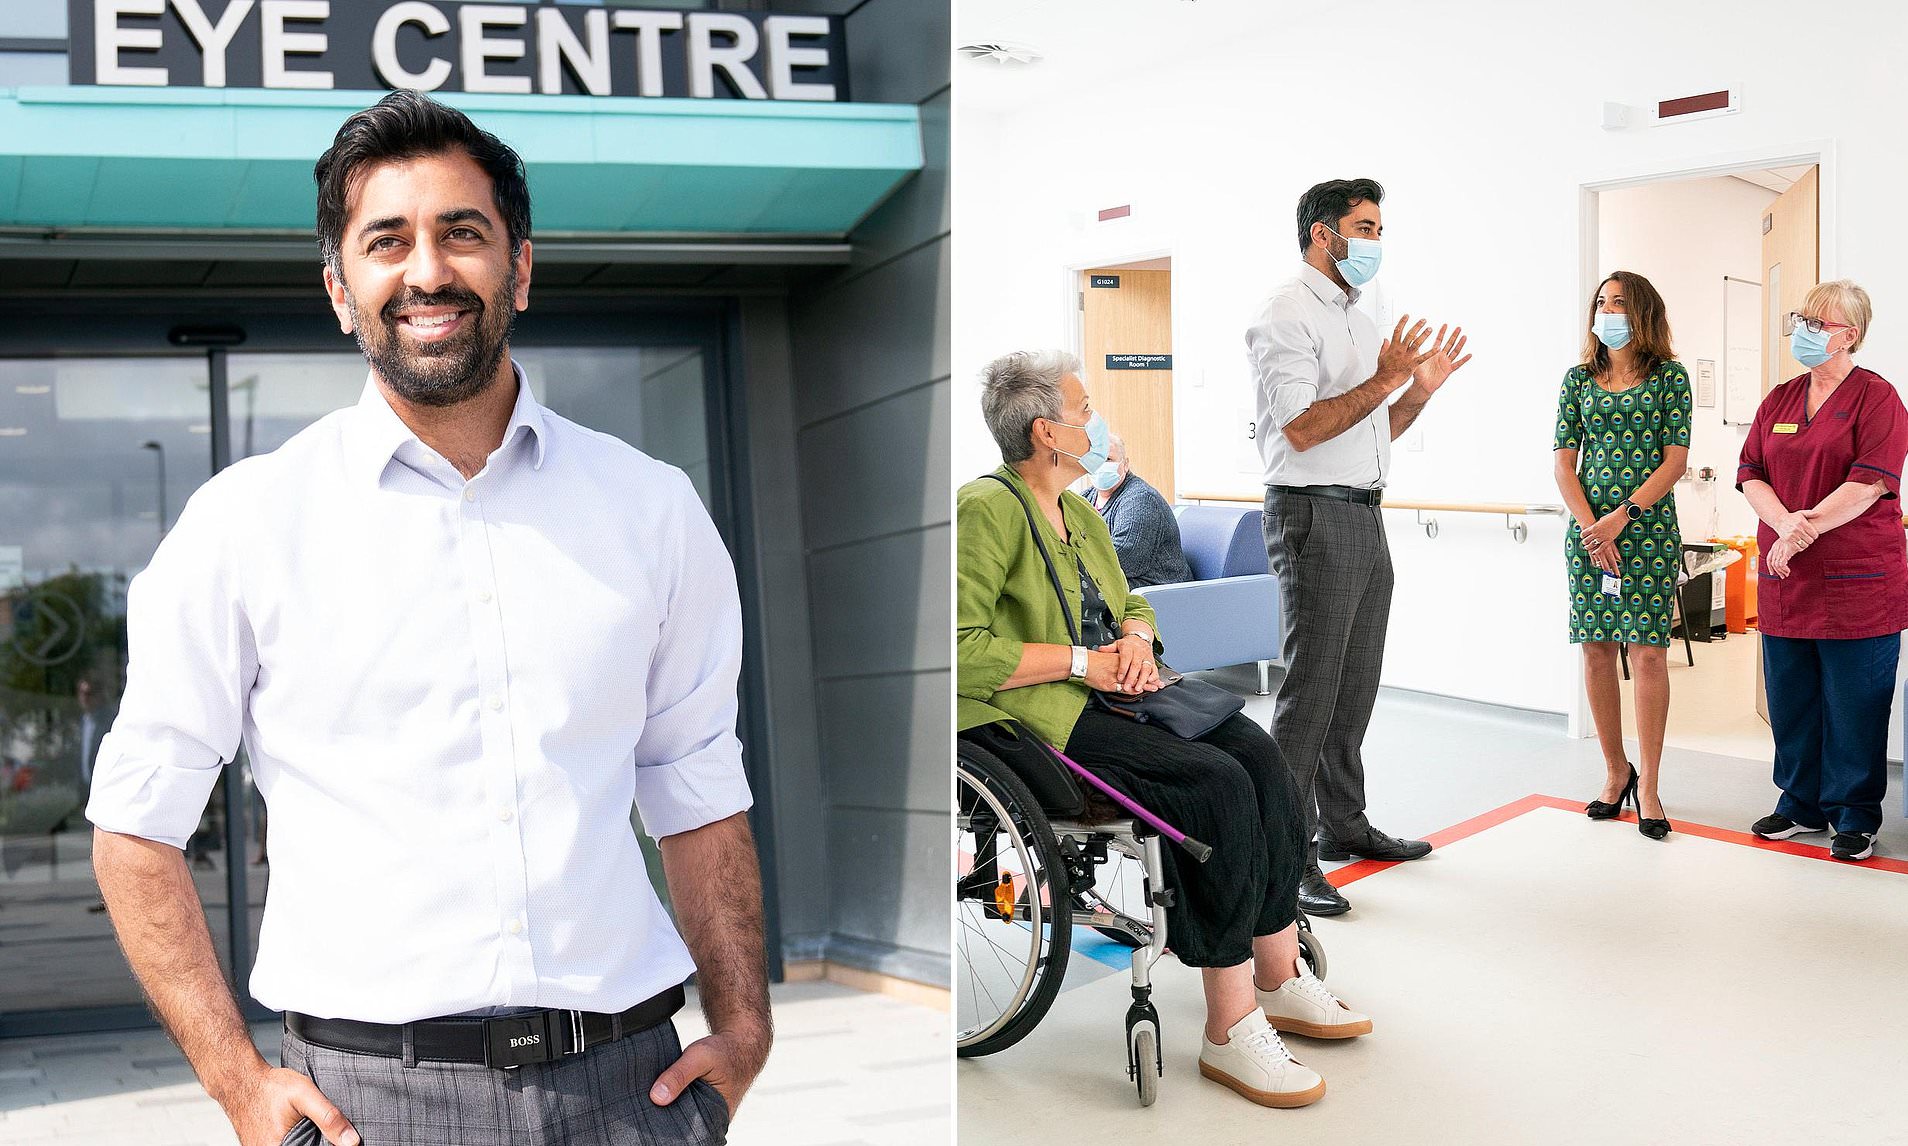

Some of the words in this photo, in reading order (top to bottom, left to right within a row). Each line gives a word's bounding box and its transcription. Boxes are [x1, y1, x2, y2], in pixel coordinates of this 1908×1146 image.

[95, 0, 334, 89] EYE
[371, 1, 836, 101] CENTRE
[1249, 422, 1256, 439] 3
[510, 1034, 540, 1048] BOSS
